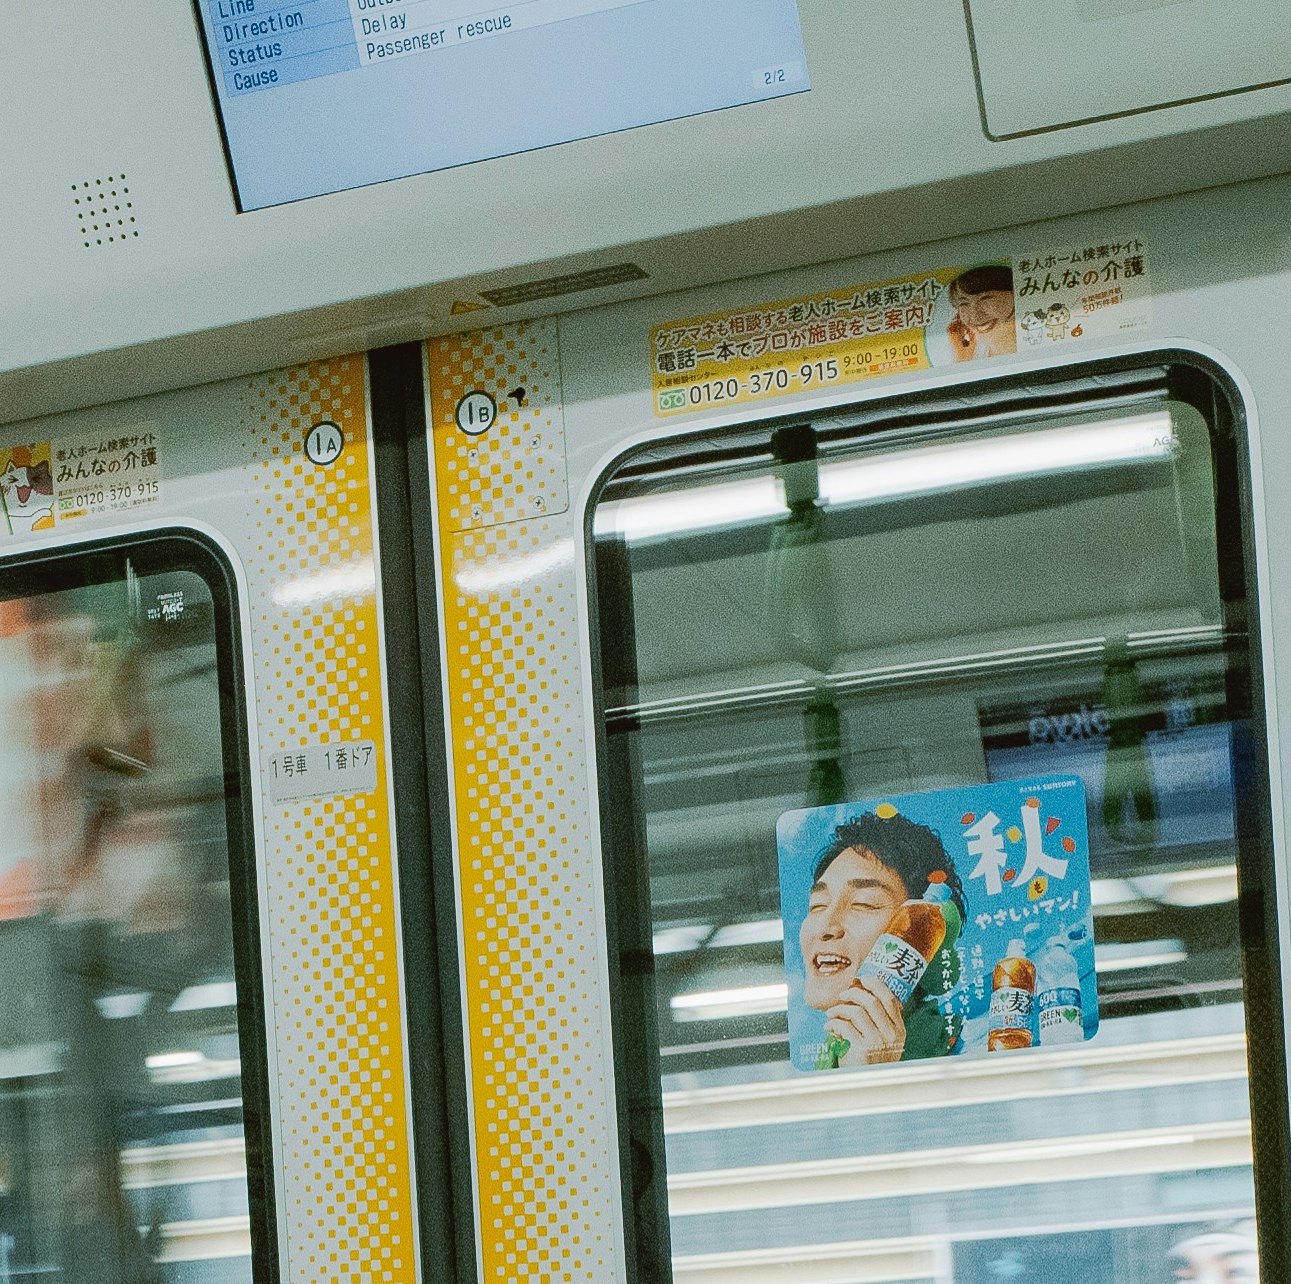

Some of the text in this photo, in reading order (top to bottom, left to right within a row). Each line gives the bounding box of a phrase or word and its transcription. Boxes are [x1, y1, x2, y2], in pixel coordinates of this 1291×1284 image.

[218, 0, 255, 19] Line
[361, 11, 407, 35] Delay
[223, 10, 304, 43] Direction
[366, 13, 513, 60] Passenger rescue
[228, 41, 283, 67] Status
[233, 69, 280, 92] Cause
[763, 69, 788, 86] 2/2
[1018, 240, 1144, 273] 老人ホーム検索サイト
[1018, 255, 1145, 297] みんなの介護
[656, 280, 942, 349] ケアマネも相談する老人ホーム検索サイト
[657, 303, 934, 373] 電話一本でプロが施設をご案内!
[689, 359, 838, 404] 0120-370-915
[55, 432, 157, 462] 老人ホーム検索サイト
[56, 446, 158, 484] みんなの介護
[75, 480, 159, 507] 0120-370-915
[271, 745, 373, 778] 1号車 1番ドア
[962, 804, 1069, 896] 秋
